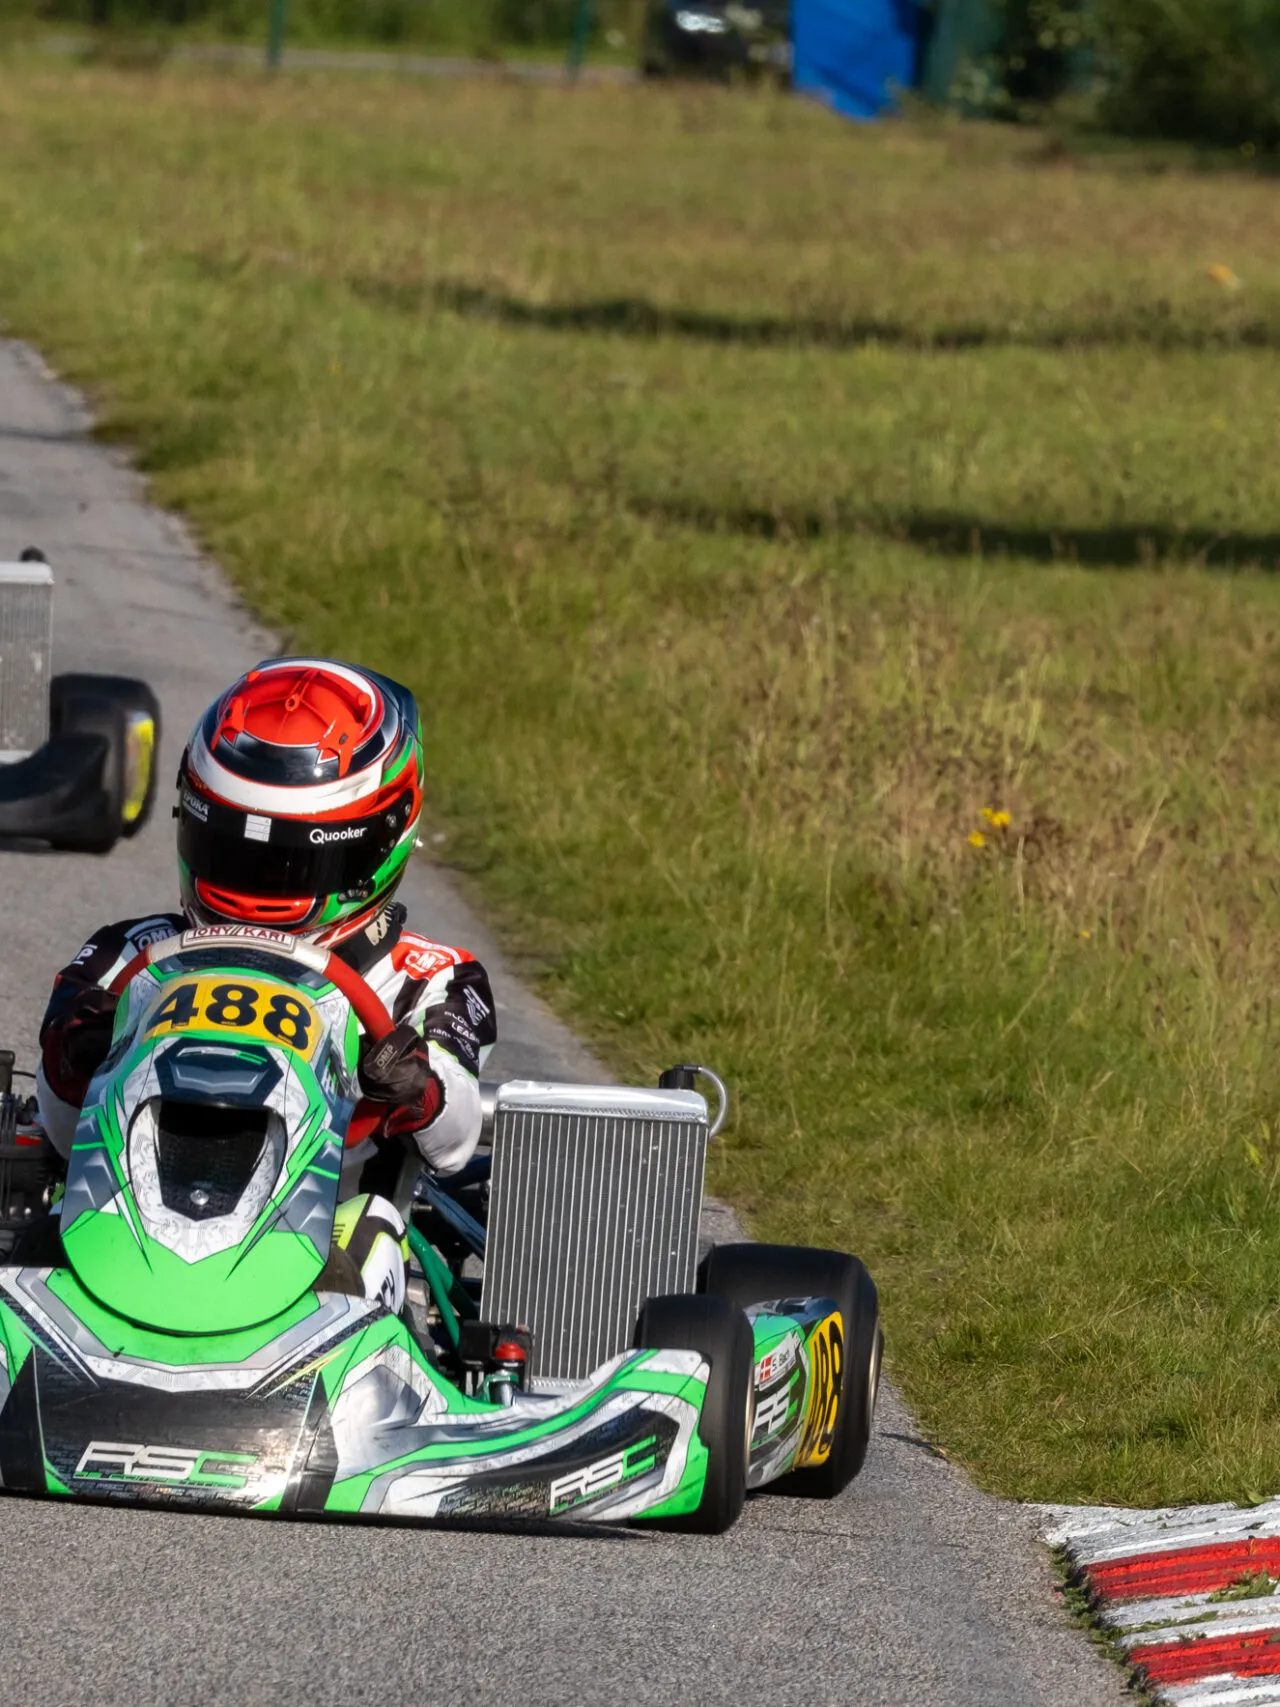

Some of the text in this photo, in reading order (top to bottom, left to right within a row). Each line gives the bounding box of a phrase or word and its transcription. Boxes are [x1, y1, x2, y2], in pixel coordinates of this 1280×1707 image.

[309, 826, 368, 844] Quooker
[145, 983, 312, 1051] 488
[376, 1044, 394, 1068] OMP
[74, 1440, 258, 1488] RSC
[550, 1434, 657, 1512] RSC
